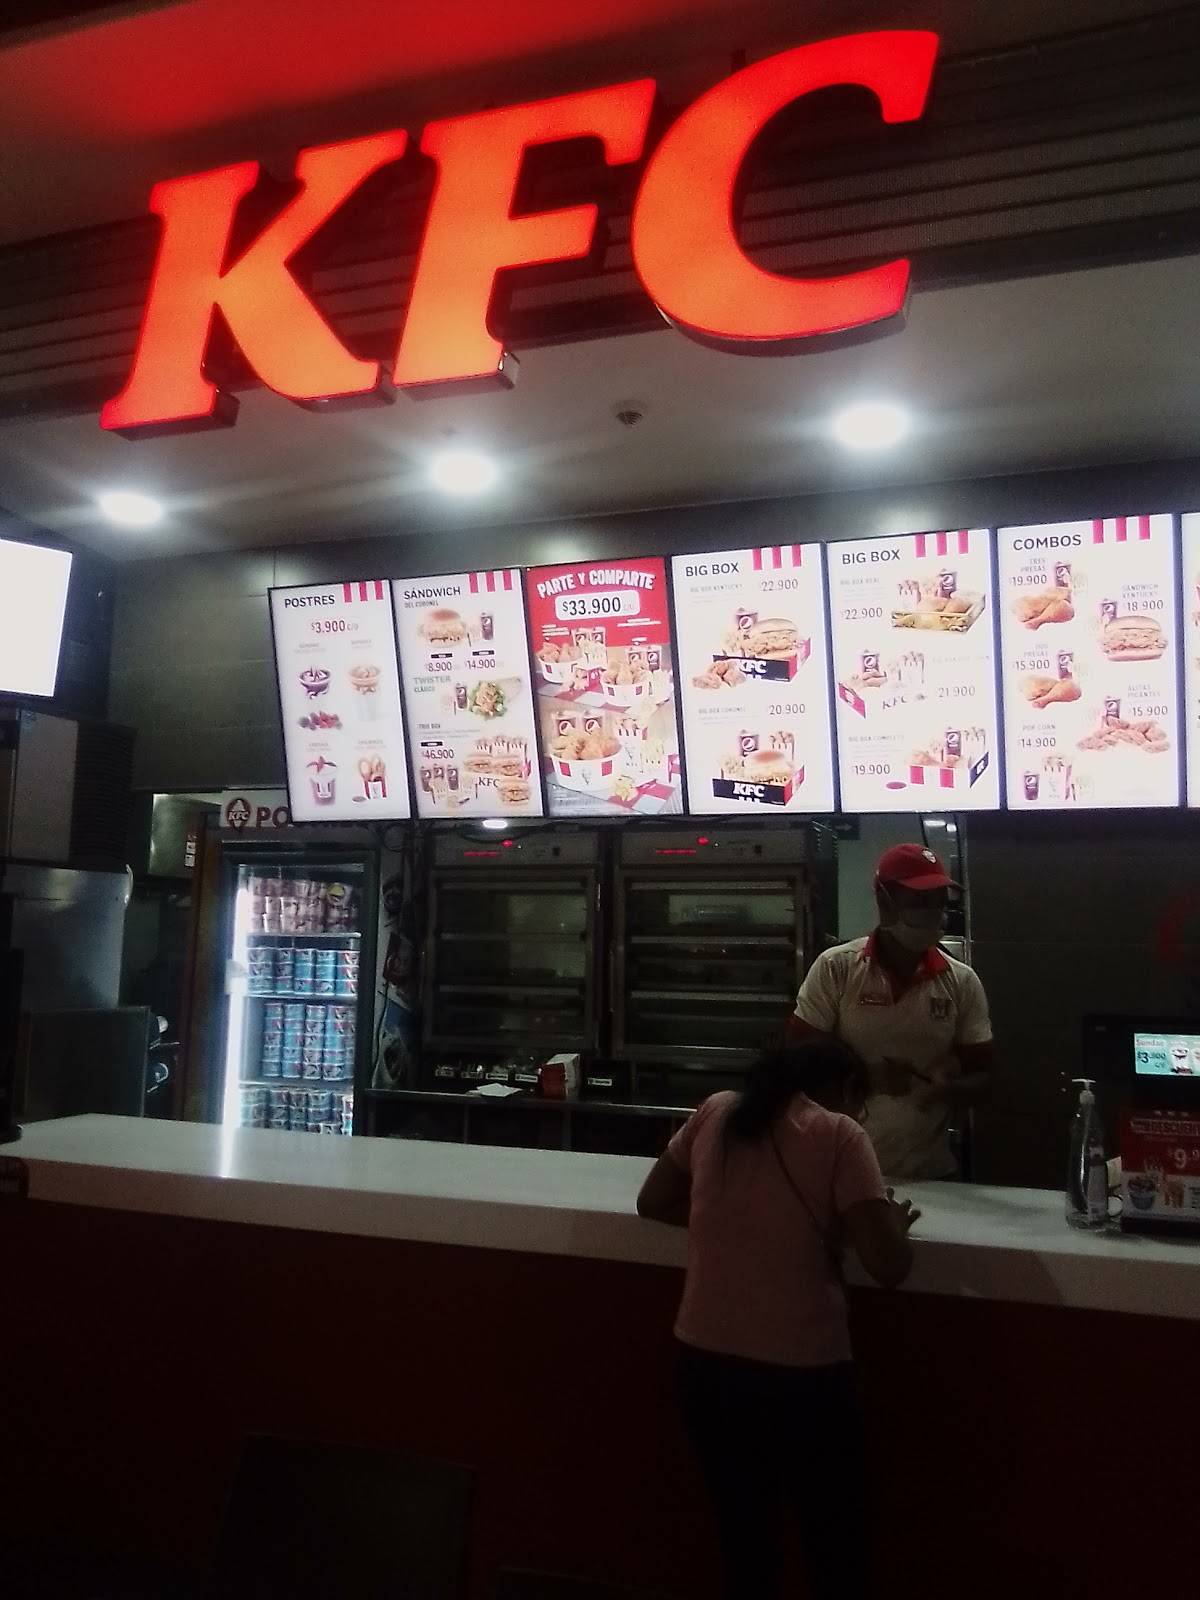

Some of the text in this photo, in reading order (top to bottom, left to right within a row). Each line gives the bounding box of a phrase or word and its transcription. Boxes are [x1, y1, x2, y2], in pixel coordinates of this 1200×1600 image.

[100, 29, 940, 432] KFC
[1013, 534, 1082, 551] COMBOS
[842, 549, 901, 565] BIG BOX
[685, 562, 740, 577] BIG BOX
[536, 569, 656, 599] PARTE Y COMPARTE
[284, 595, 335, 609] POSTRES
[562, 597, 621, 616] $33.900
[311, 620, 346, 634] $3.900
[478, 776, 500, 788] KFC
[733, 782, 766, 797] KFC
